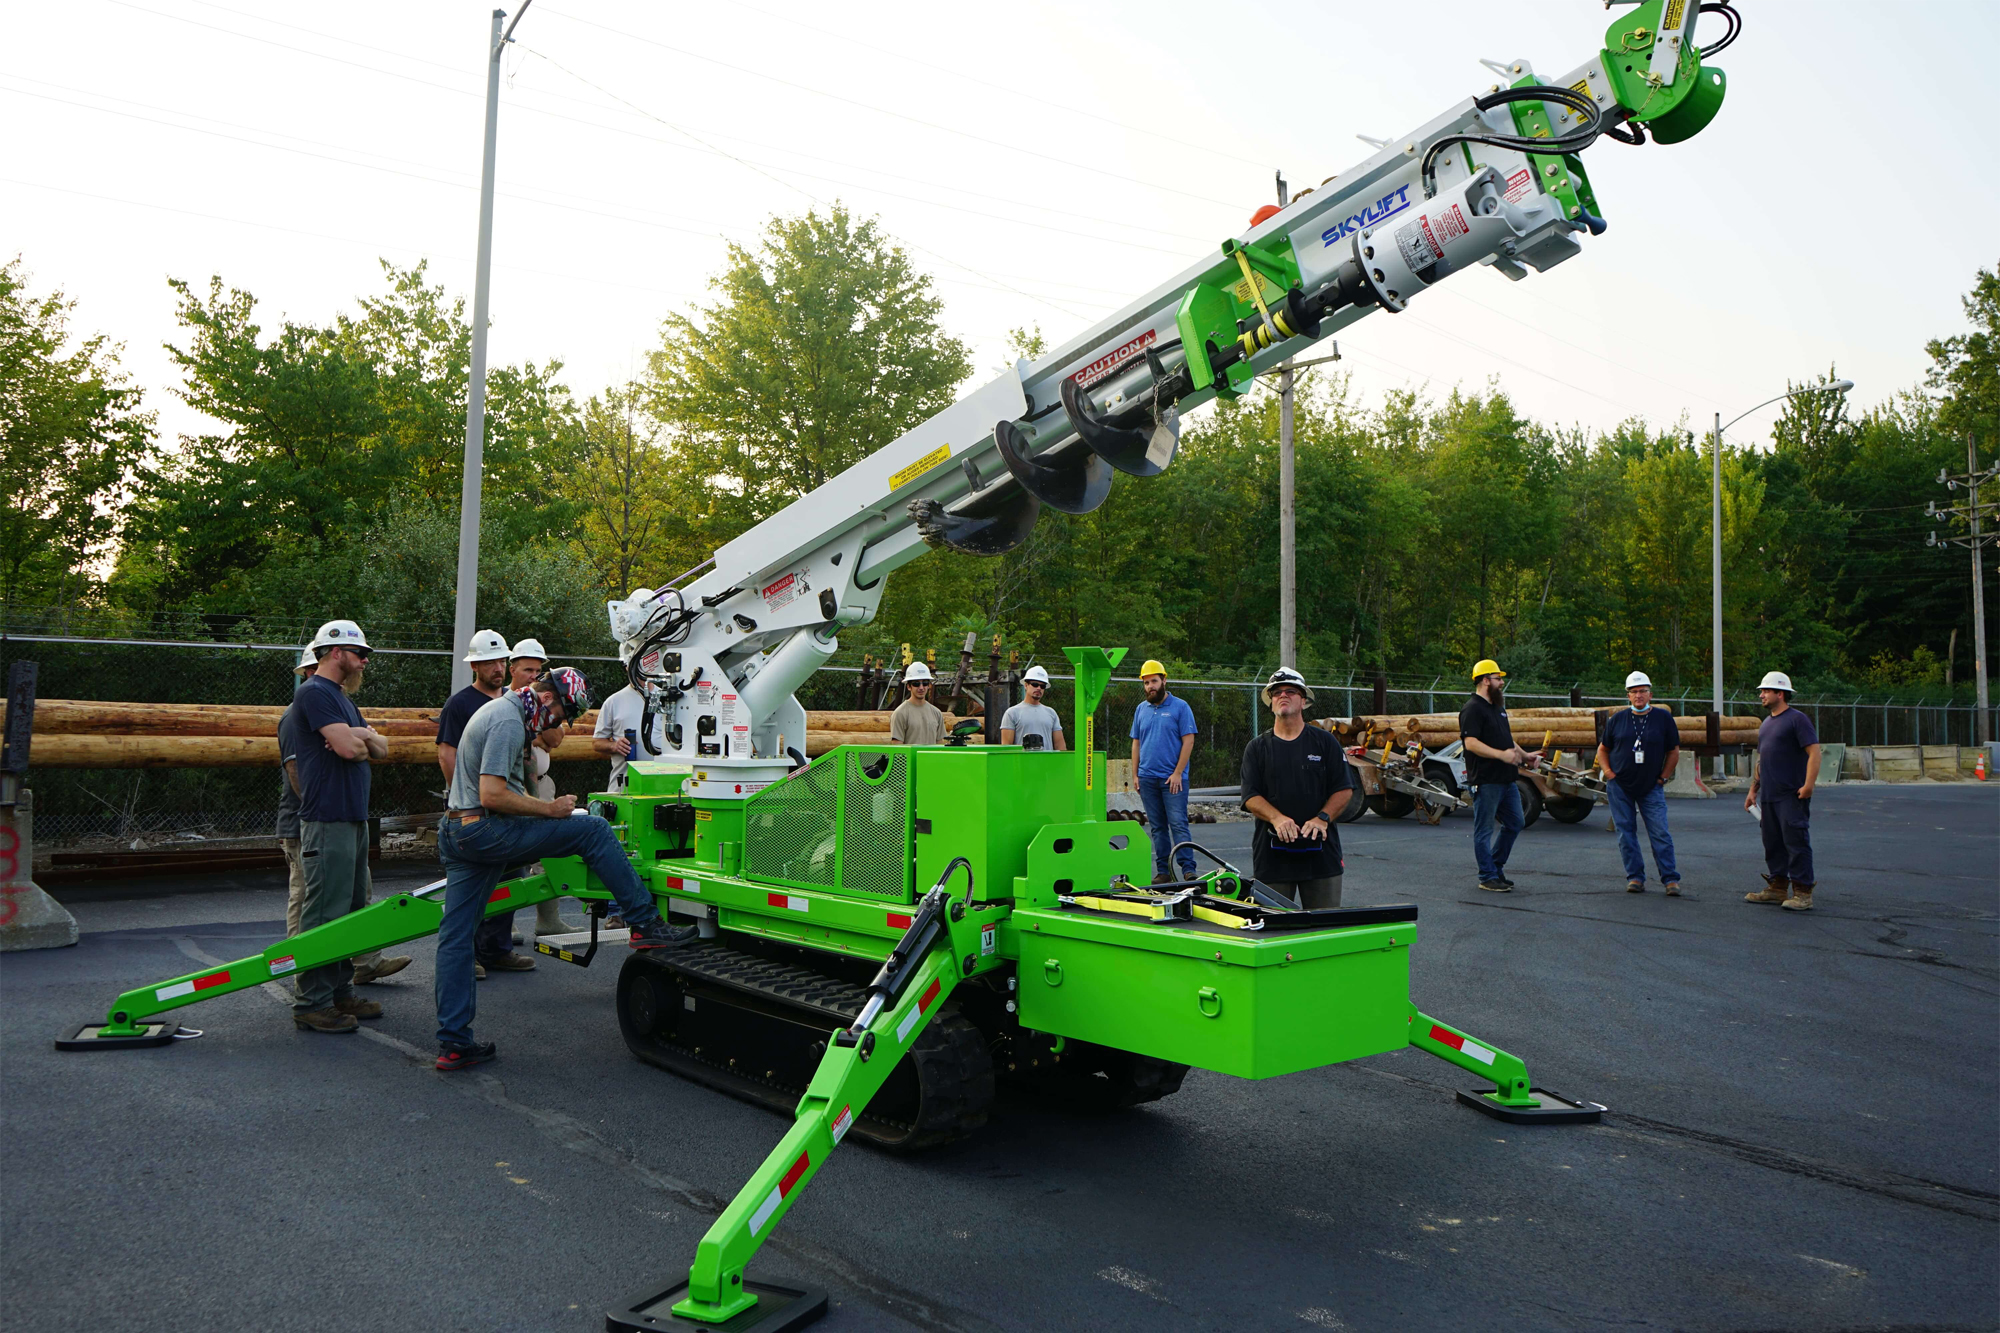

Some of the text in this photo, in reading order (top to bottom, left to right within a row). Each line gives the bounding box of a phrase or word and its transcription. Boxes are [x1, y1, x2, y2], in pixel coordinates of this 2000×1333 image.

[1664, 0, 1675, 28] CAUTIO
[1321, 183, 1410, 248] SKYLIFT
[1424, 226, 1441, 255] DANGER
[1075, 339, 1140, 383] CAUTION
[770, 575, 794, 592] DANGER
